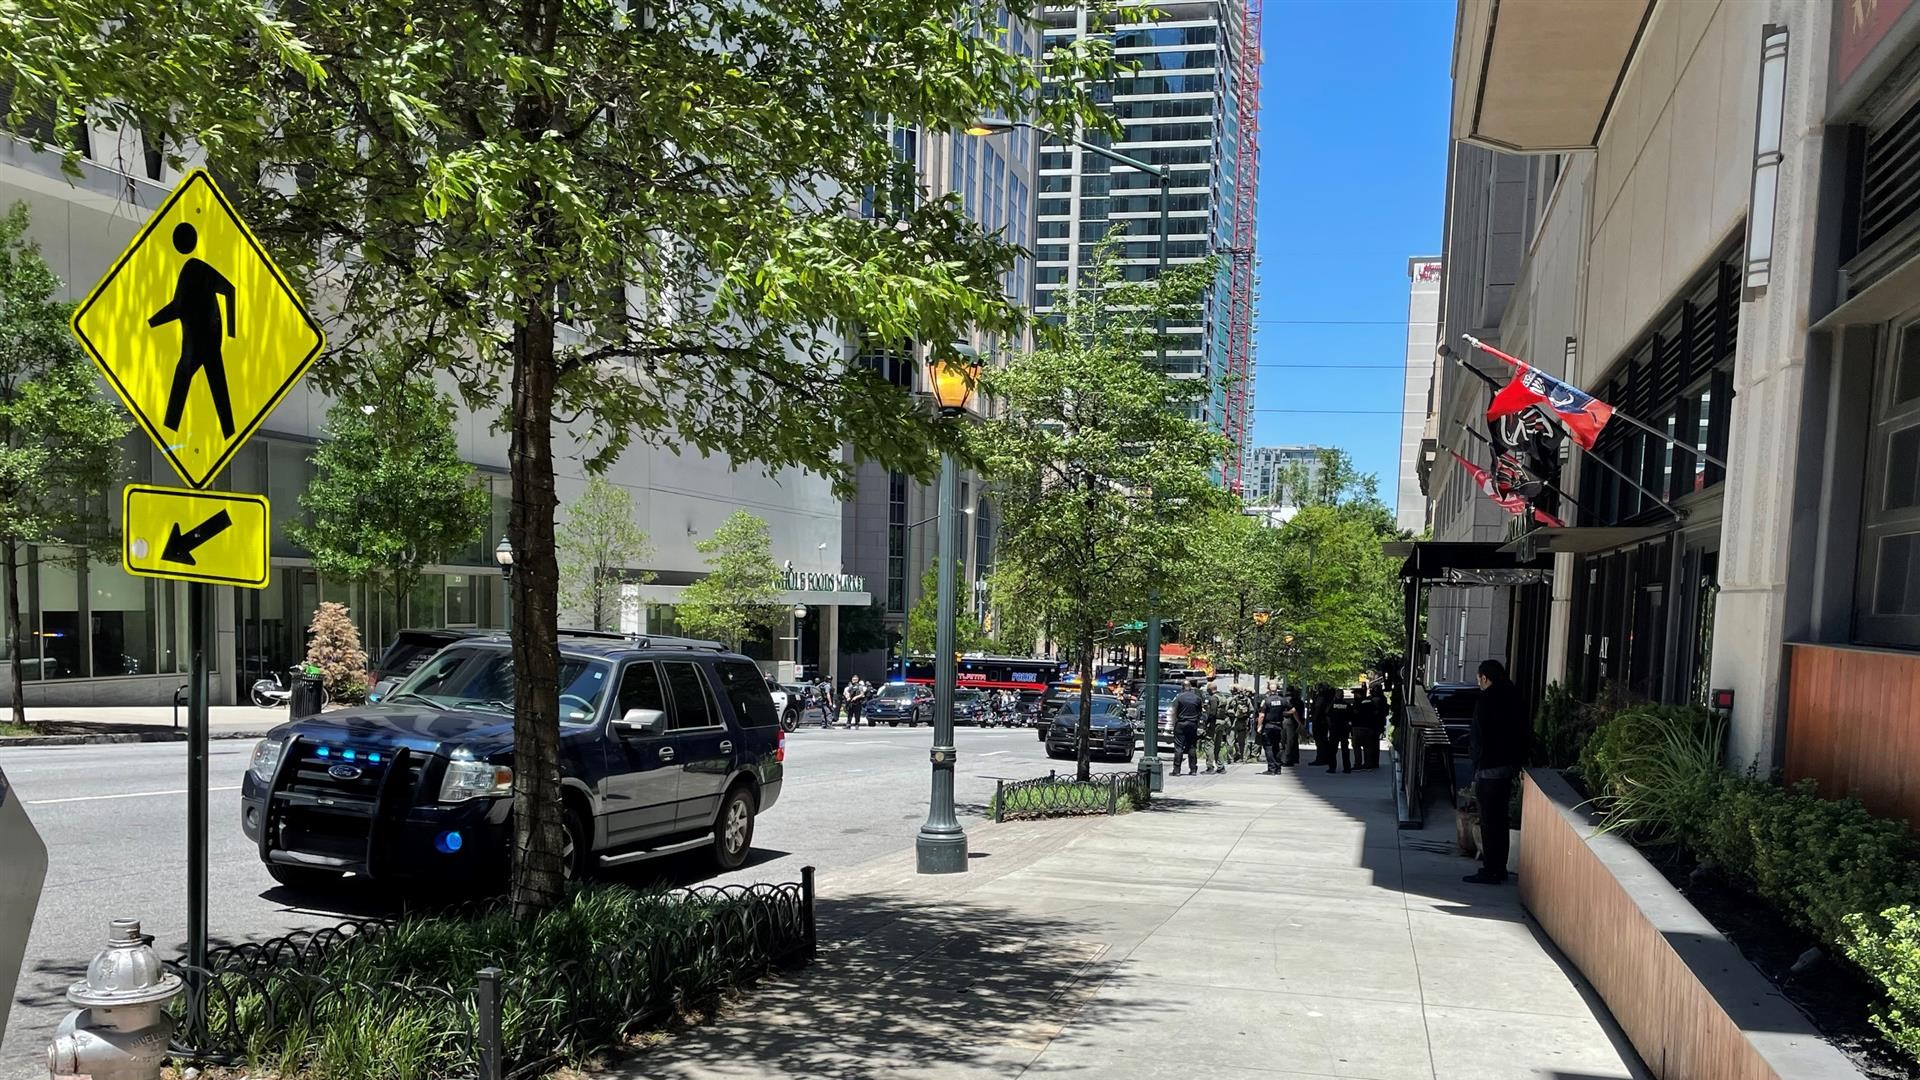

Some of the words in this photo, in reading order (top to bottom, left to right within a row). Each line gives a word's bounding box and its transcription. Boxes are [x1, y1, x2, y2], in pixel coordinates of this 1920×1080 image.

[808, 572, 834, 591] FOODS
[836, 574, 865, 592] MARKET
[958, 673, 986, 681] TLANTA
[1011, 672, 1037, 682] POLICE
